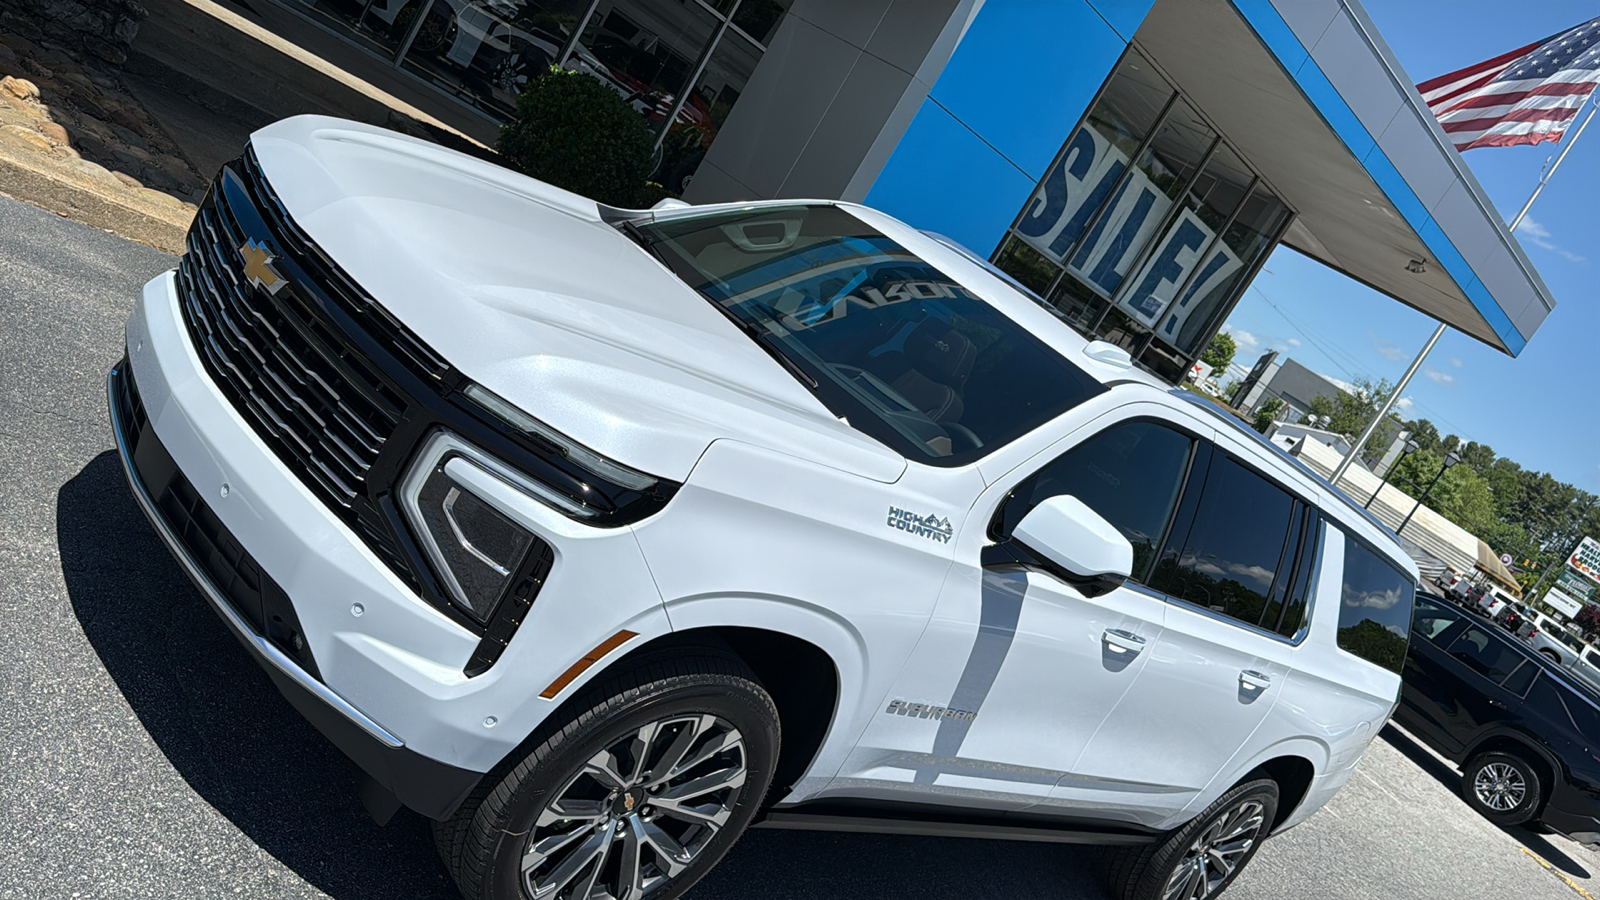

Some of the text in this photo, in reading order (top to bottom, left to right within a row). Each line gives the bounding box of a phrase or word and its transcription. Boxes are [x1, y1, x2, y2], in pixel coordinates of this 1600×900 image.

[1017, 126, 1231, 336] SALE!
[888, 505, 926, 526] HIGH
[887, 516, 952, 544] COUNTRY
[885, 699, 978, 721] SUBURBAN
